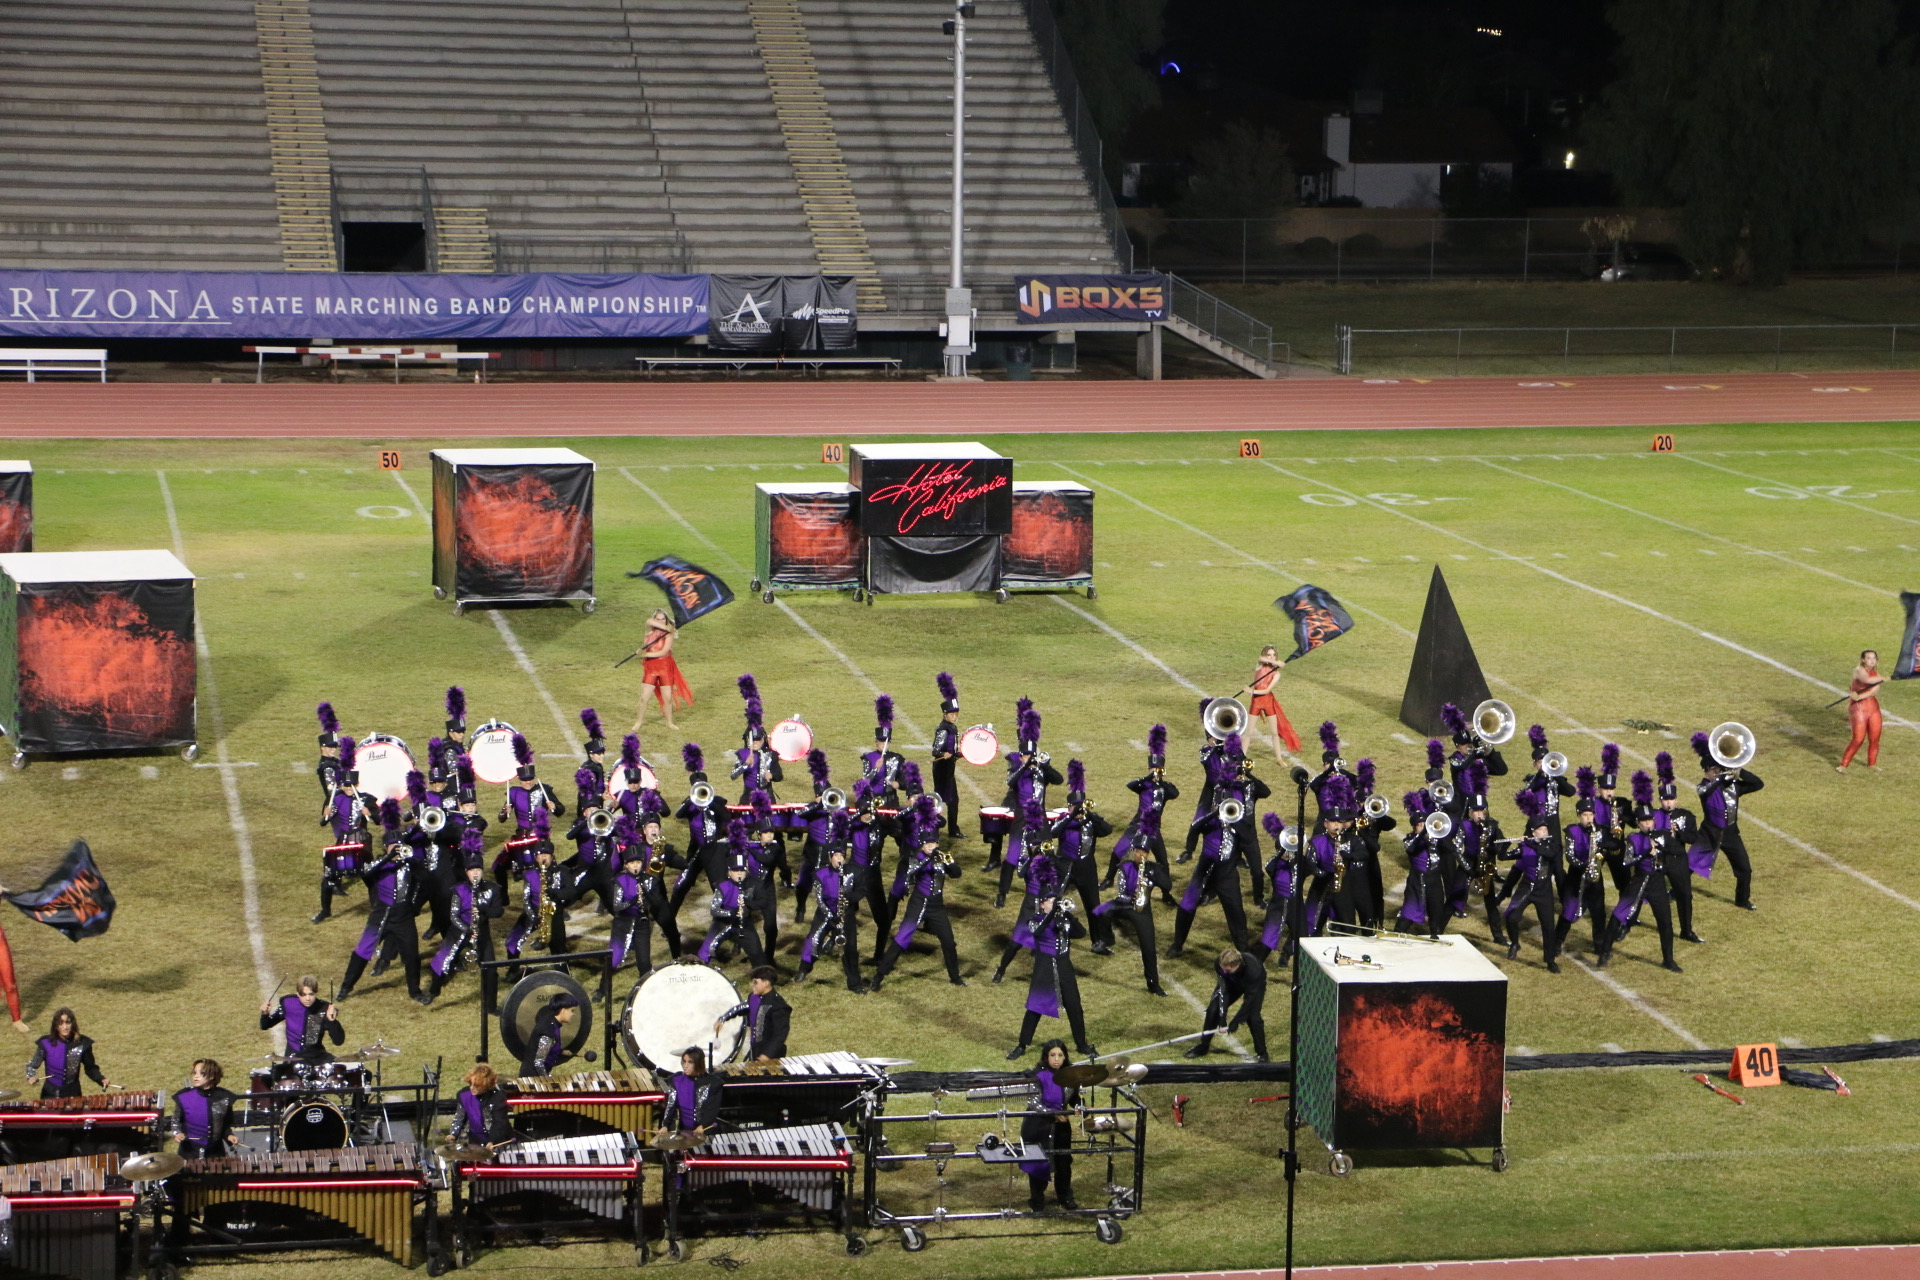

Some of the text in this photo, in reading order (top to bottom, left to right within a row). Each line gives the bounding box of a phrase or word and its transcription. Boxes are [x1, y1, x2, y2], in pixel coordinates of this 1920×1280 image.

[232, 296, 303, 315] STATE
[316, 297, 438, 315] MARCHING
[450, 297, 512, 315] BAND
[523, 296, 694, 315] CHAMPIONSHIP
[815, 307, 850, 316] SpeedPro
[1244, 441, 1260, 456] 30
[1657, 435, 1672, 451] 20
[382, 452, 399, 468] 50
[825, 445, 841, 461] 40
[868, 459, 974, 505] Hotel
[898, 475, 1008, 534] California
[485, 734, 506, 744] Pearl
[366, 749, 388, 762] Pearl
[1745, 1047, 1775, 1078] 40
